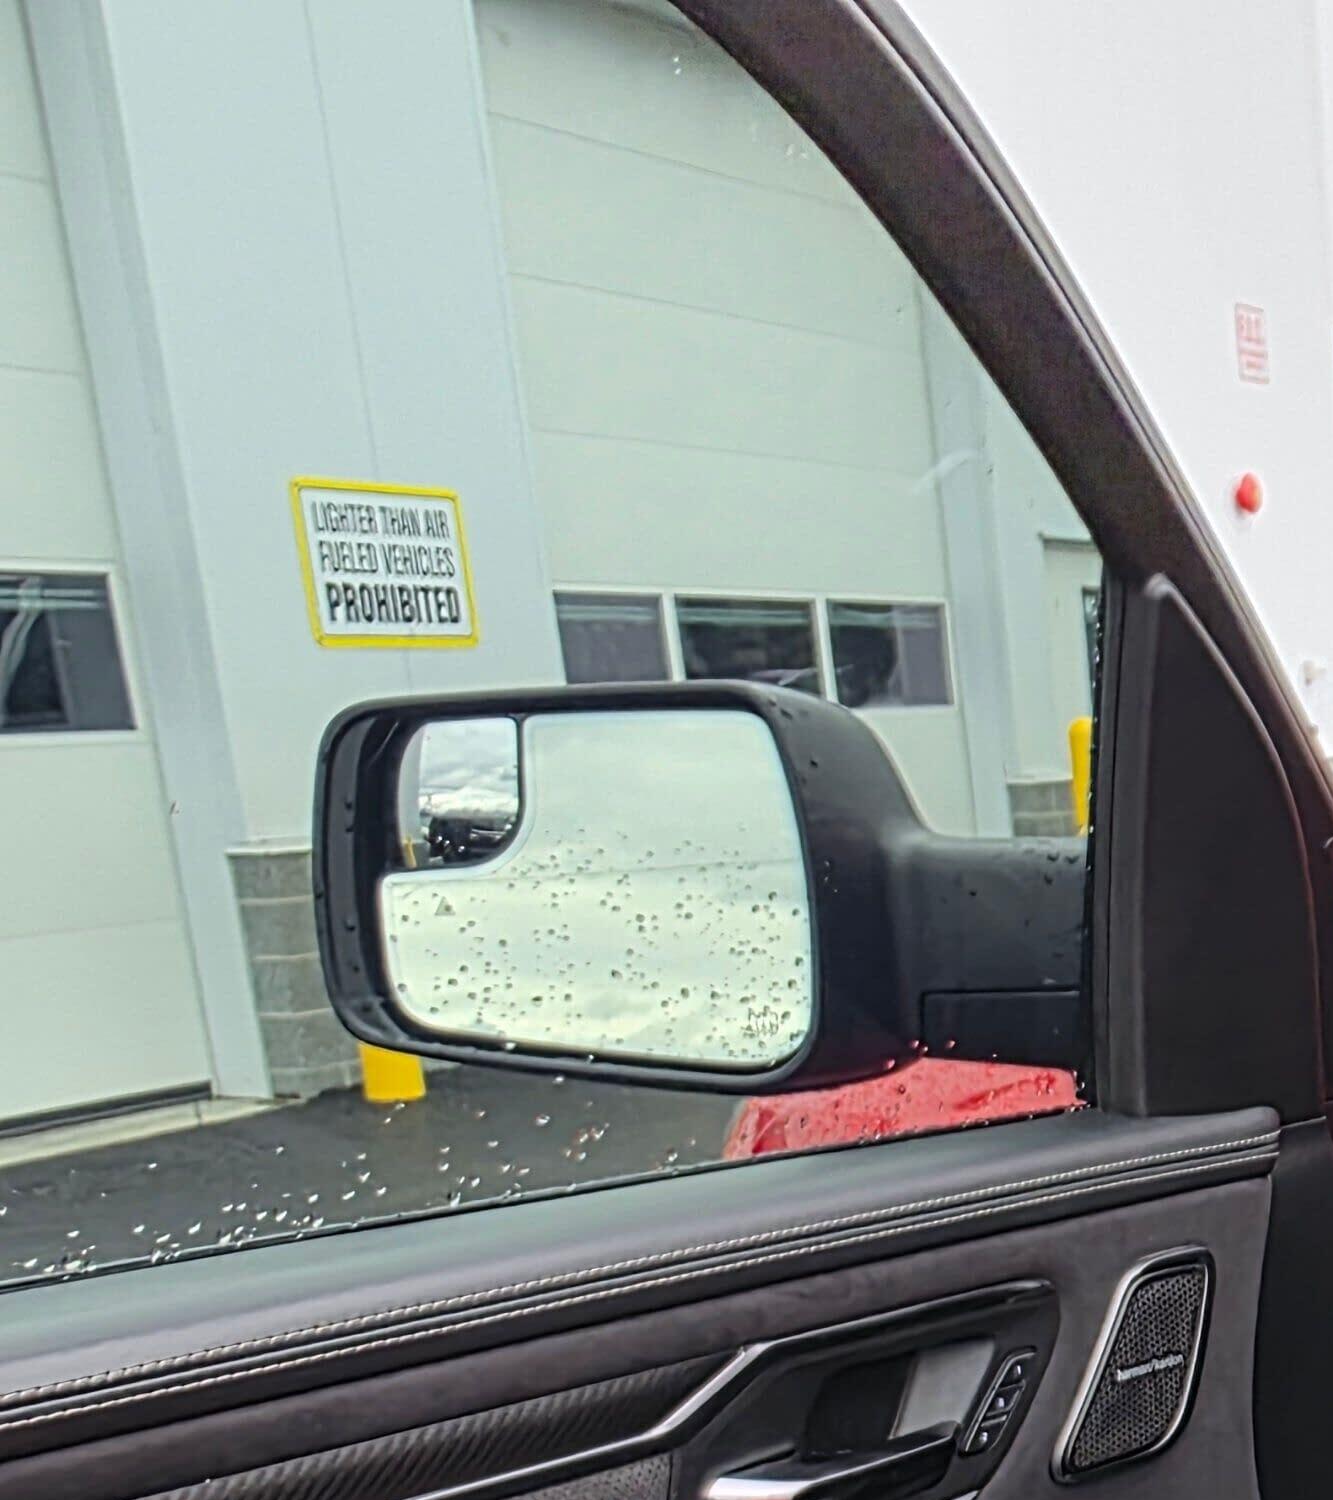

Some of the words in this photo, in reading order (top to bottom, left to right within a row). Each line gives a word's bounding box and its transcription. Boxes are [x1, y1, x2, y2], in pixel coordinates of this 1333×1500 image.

[311, 501, 378, 534] LIGHTER
[378, 505, 421, 537] THAN
[423, 509, 450, 539] AIR
[319, 540, 379, 573] FUELED
[380, 543, 456, 578] VEHICLES
[325, 581, 462, 624] PROHIBITED
